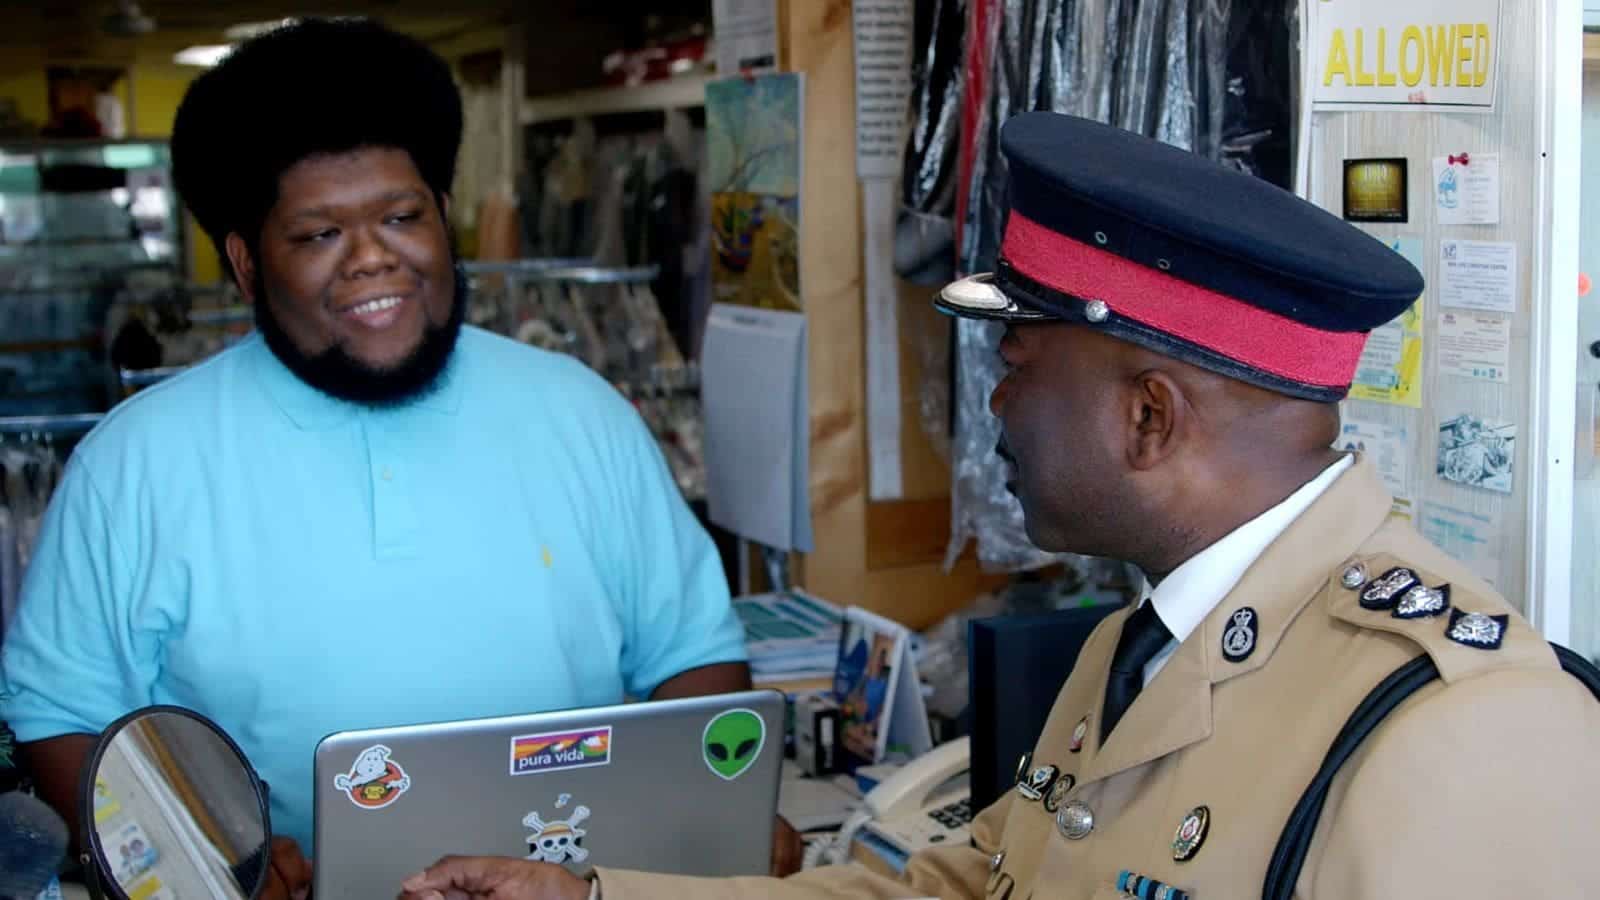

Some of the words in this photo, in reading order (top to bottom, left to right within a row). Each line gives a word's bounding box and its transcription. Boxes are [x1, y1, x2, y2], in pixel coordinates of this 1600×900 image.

[1323, 23, 1490, 87] ALLOWED
[520, 754, 551, 769] pura
[555, 749, 584, 763] vida
